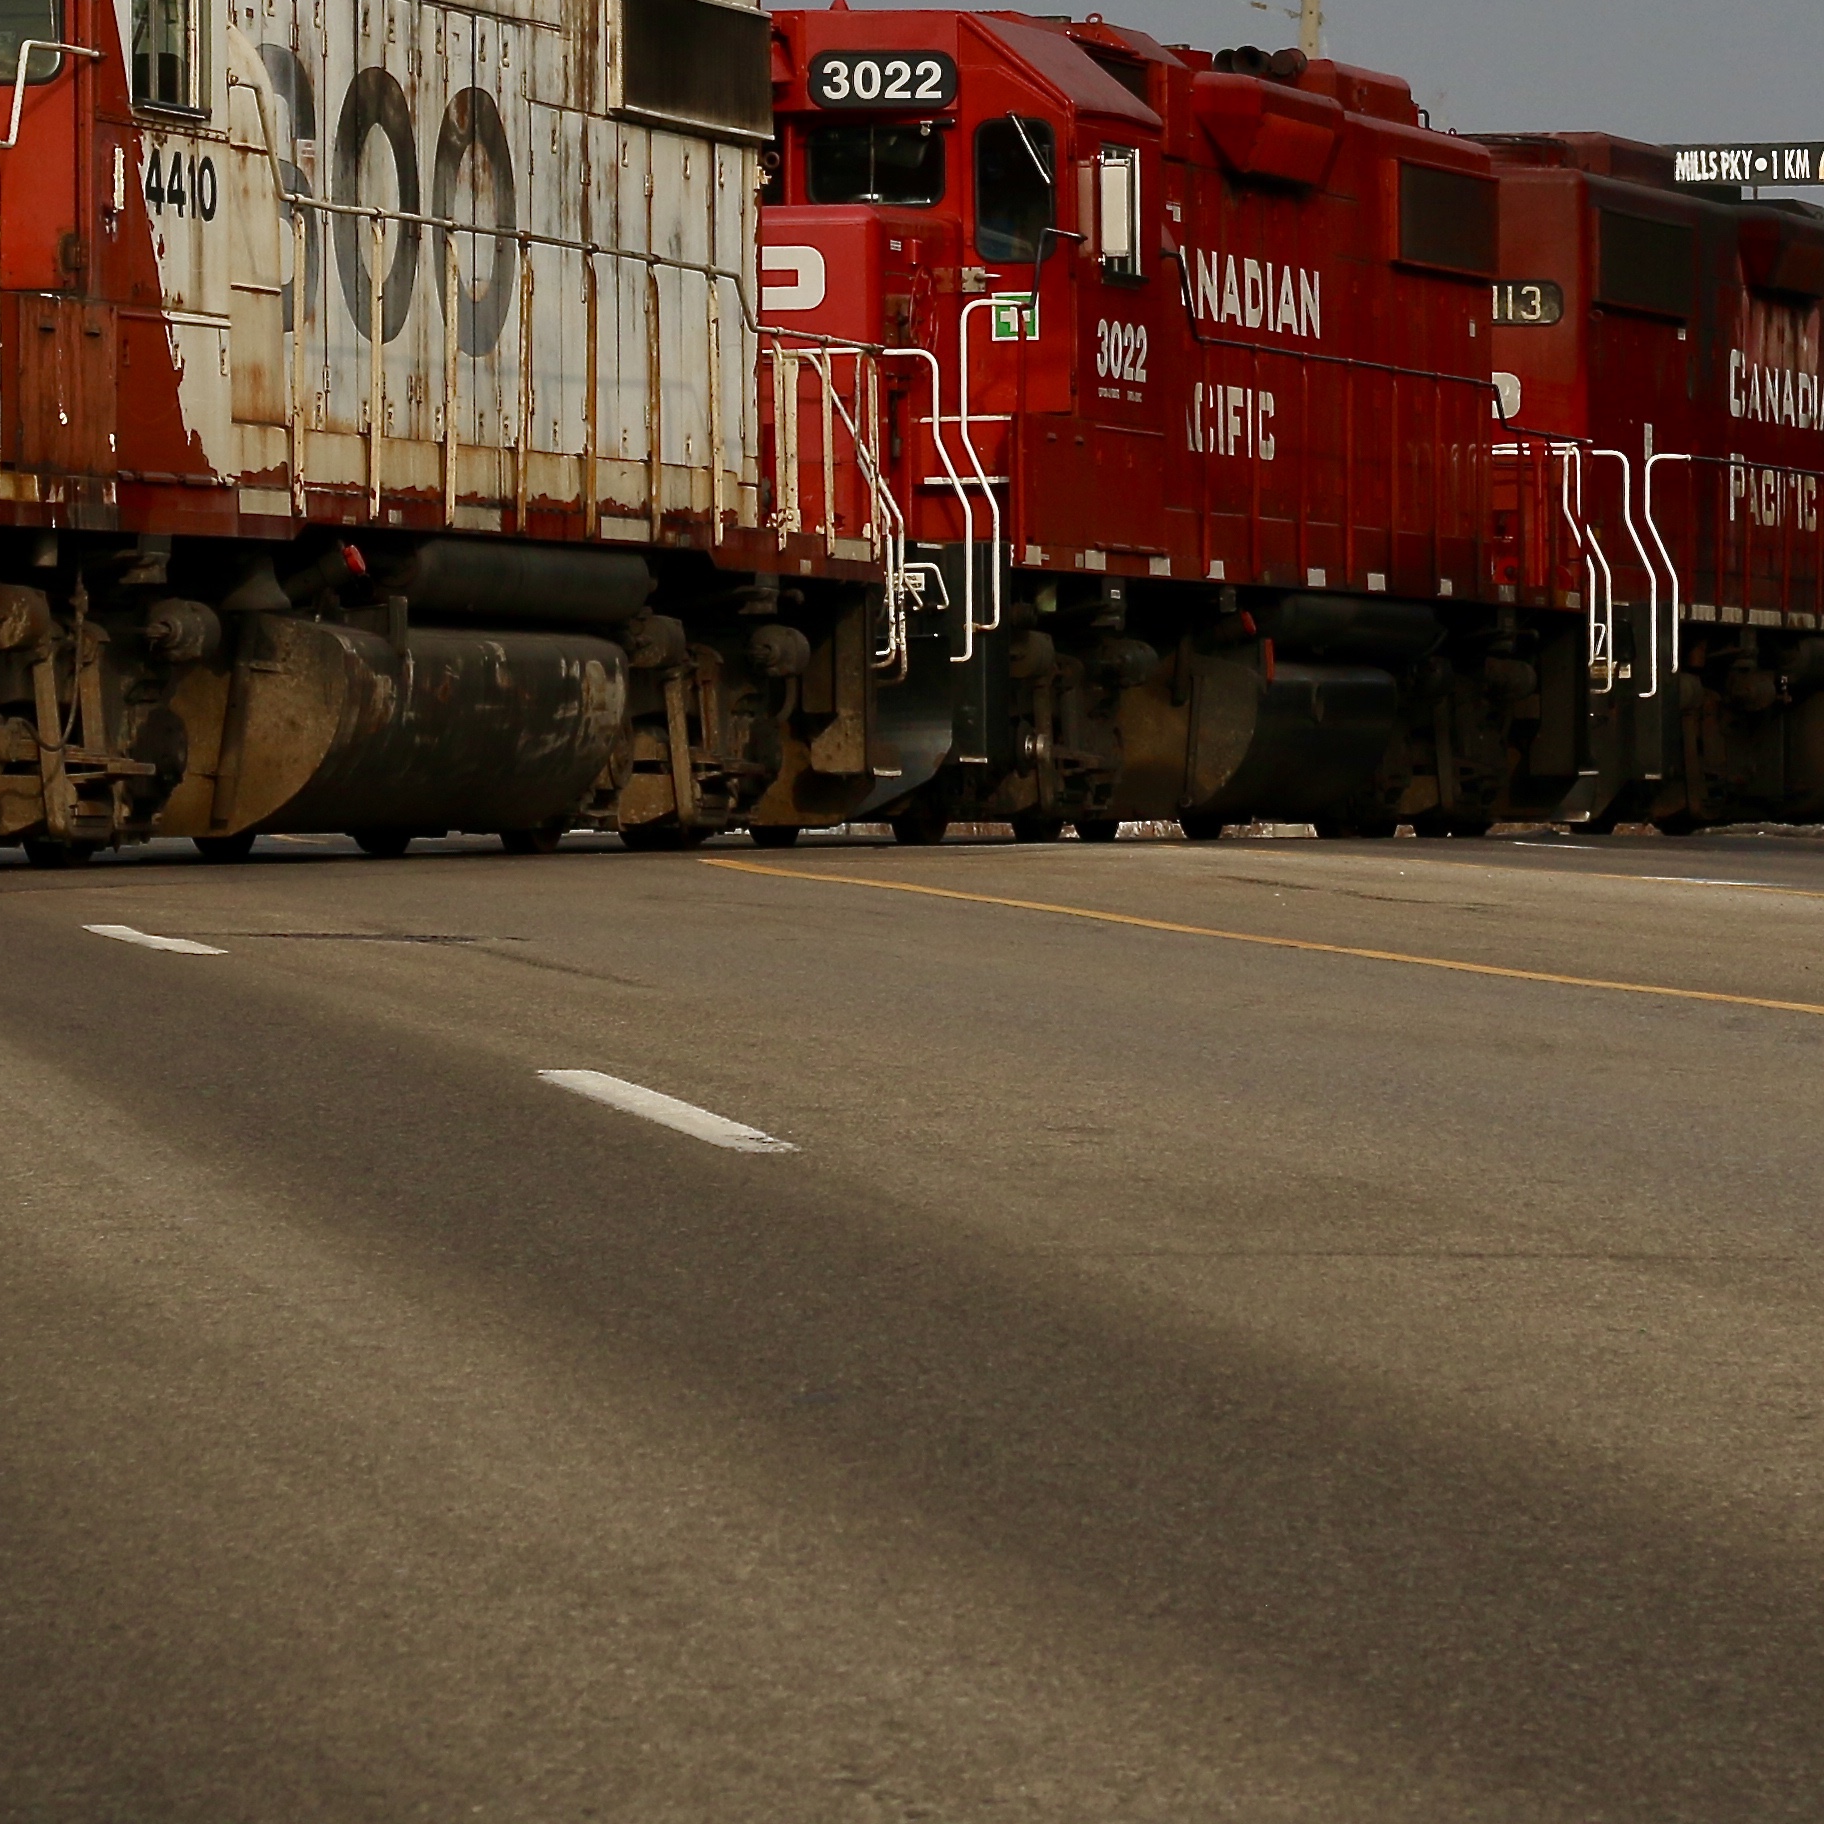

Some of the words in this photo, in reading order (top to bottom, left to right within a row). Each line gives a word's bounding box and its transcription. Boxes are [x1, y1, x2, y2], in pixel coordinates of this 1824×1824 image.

[822, 60, 943, 100] 3022
[145, 148, 218, 223] 4410
[1675, 150, 1717, 181] MILLS
[1720, 149, 1753, 180] PKY
[1771, 151, 1778, 180] 1
[1784, 148, 1811, 180] KM
[1179, 244, 1320, 339] NADIAN
[1491, 285, 1542, 320] 113
[1096, 318, 1148, 384] 3022
[1185, 381, 1275, 461] CIFIC
